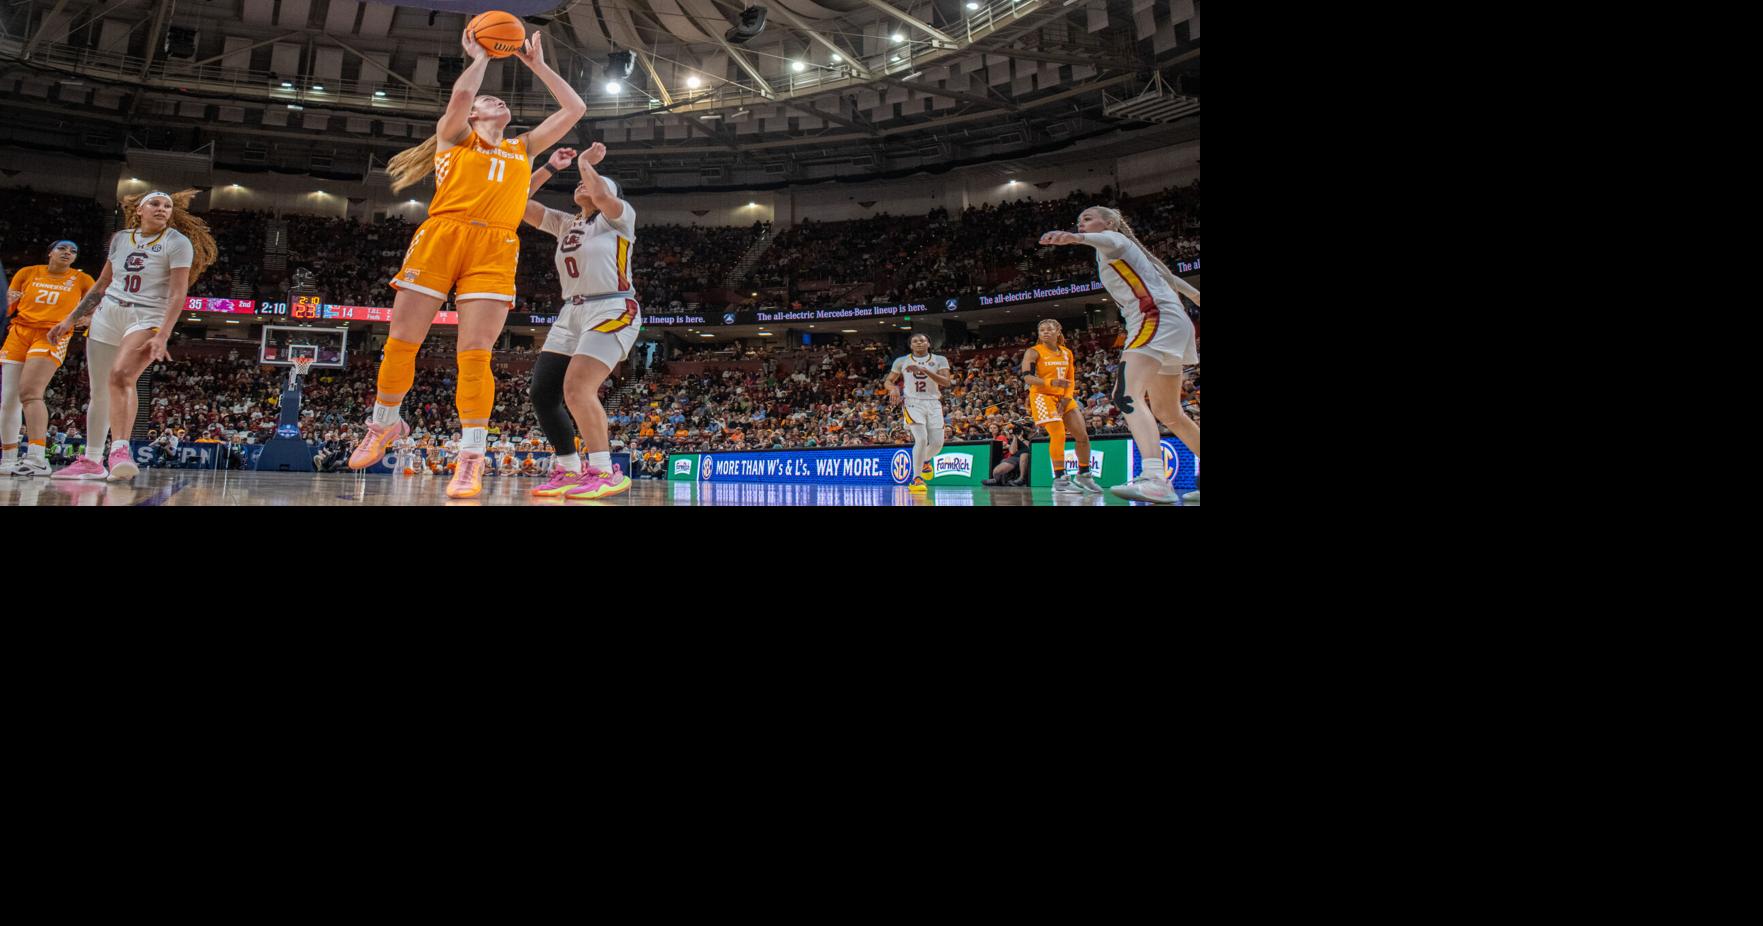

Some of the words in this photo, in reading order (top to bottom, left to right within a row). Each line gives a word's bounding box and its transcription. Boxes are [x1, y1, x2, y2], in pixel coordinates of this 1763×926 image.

[488, 157, 505, 182] 11
[564, 256, 580, 279] 0
[1177, 262, 1192, 273] The
[123, 274, 142, 293] 10
[35, 289, 60, 305] 20
[299, 296, 320, 305] 2:10
[979, 296, 993, 306] The
[994, 290, 1032, 304] all-electric
[1033, 283, 1090, 299] Mercedes-Benz
[189, 298, 202, 310] 35
[261, 301, 286, 315] 2:10
[295, 304, 316, 319] 23
[342, 307, 353, 318] 14
[757, 313, 772, 321] The
[773, 311, 814, 321] all-electric
[816, 308, 873, 319] Mercedes-Benz
[874, 305, 898, 315] lineup
[899, 304, 907, 313] is
[908, 303, 928, 312] here.
[530, 315, 545, 324] The
[650, 315, 675, 325] lineup
[677, 315, 684, 323] is
[686, 315, 706, 323] here.
[1056, 366, 1067, 380] 15
[915, 381, 926, 392] 12
[716, 460, 739, 475] MORE
[741, 459, 764, 475] THAN
[767, 459, 783, 476] W's
[785, 459, 792, 475] &
[795, 458, 810, 476] L's.
[816, 458, 841, 476] WAY
[843, 457, 883, 477] MORE.
[893, 453, 909, 480] SEC
